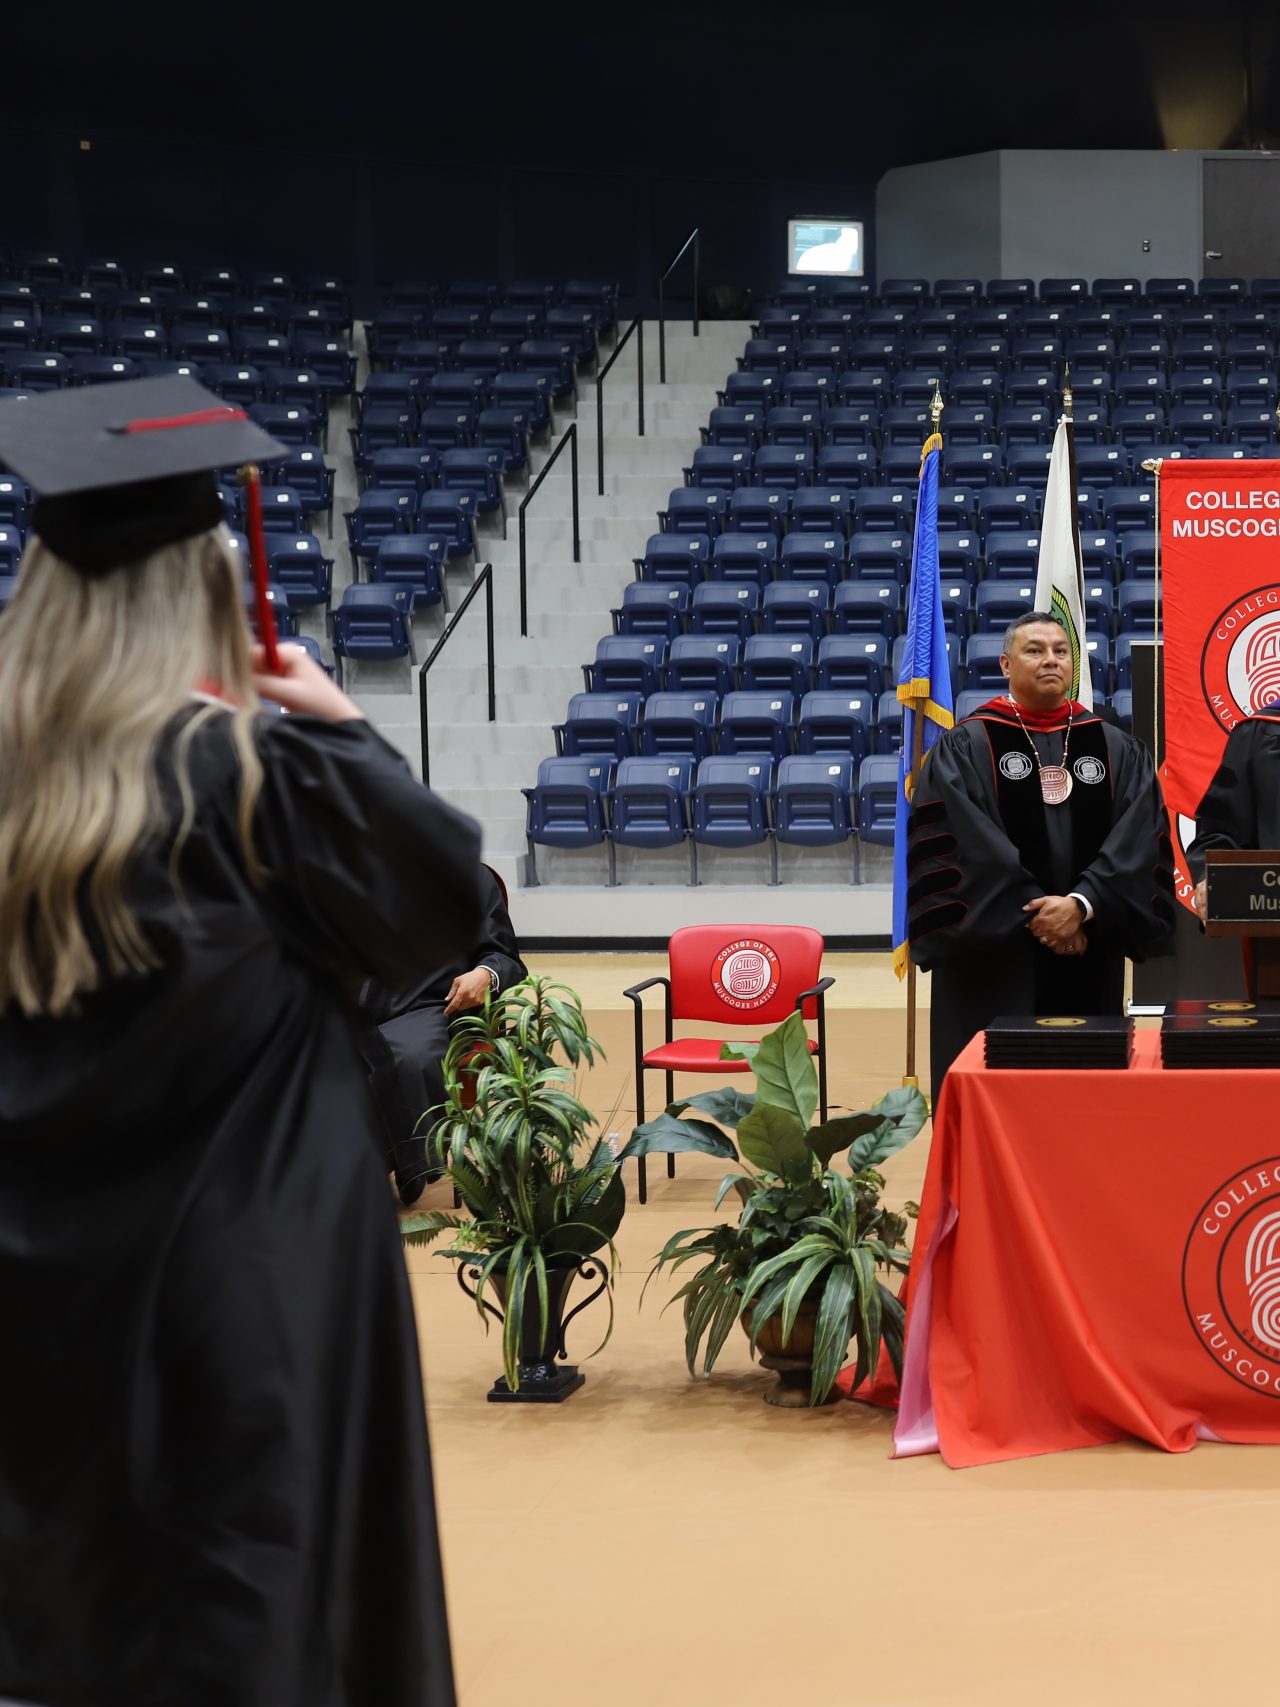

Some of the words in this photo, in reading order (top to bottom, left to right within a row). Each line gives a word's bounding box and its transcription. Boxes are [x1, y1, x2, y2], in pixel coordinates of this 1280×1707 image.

[717, 941, 750, 961] COLLEGE
[764, 948, 777, 963] THE
[713, 982, 750, 1008] MUSCOGEE
[753, 982, 777, 1007] NATION
